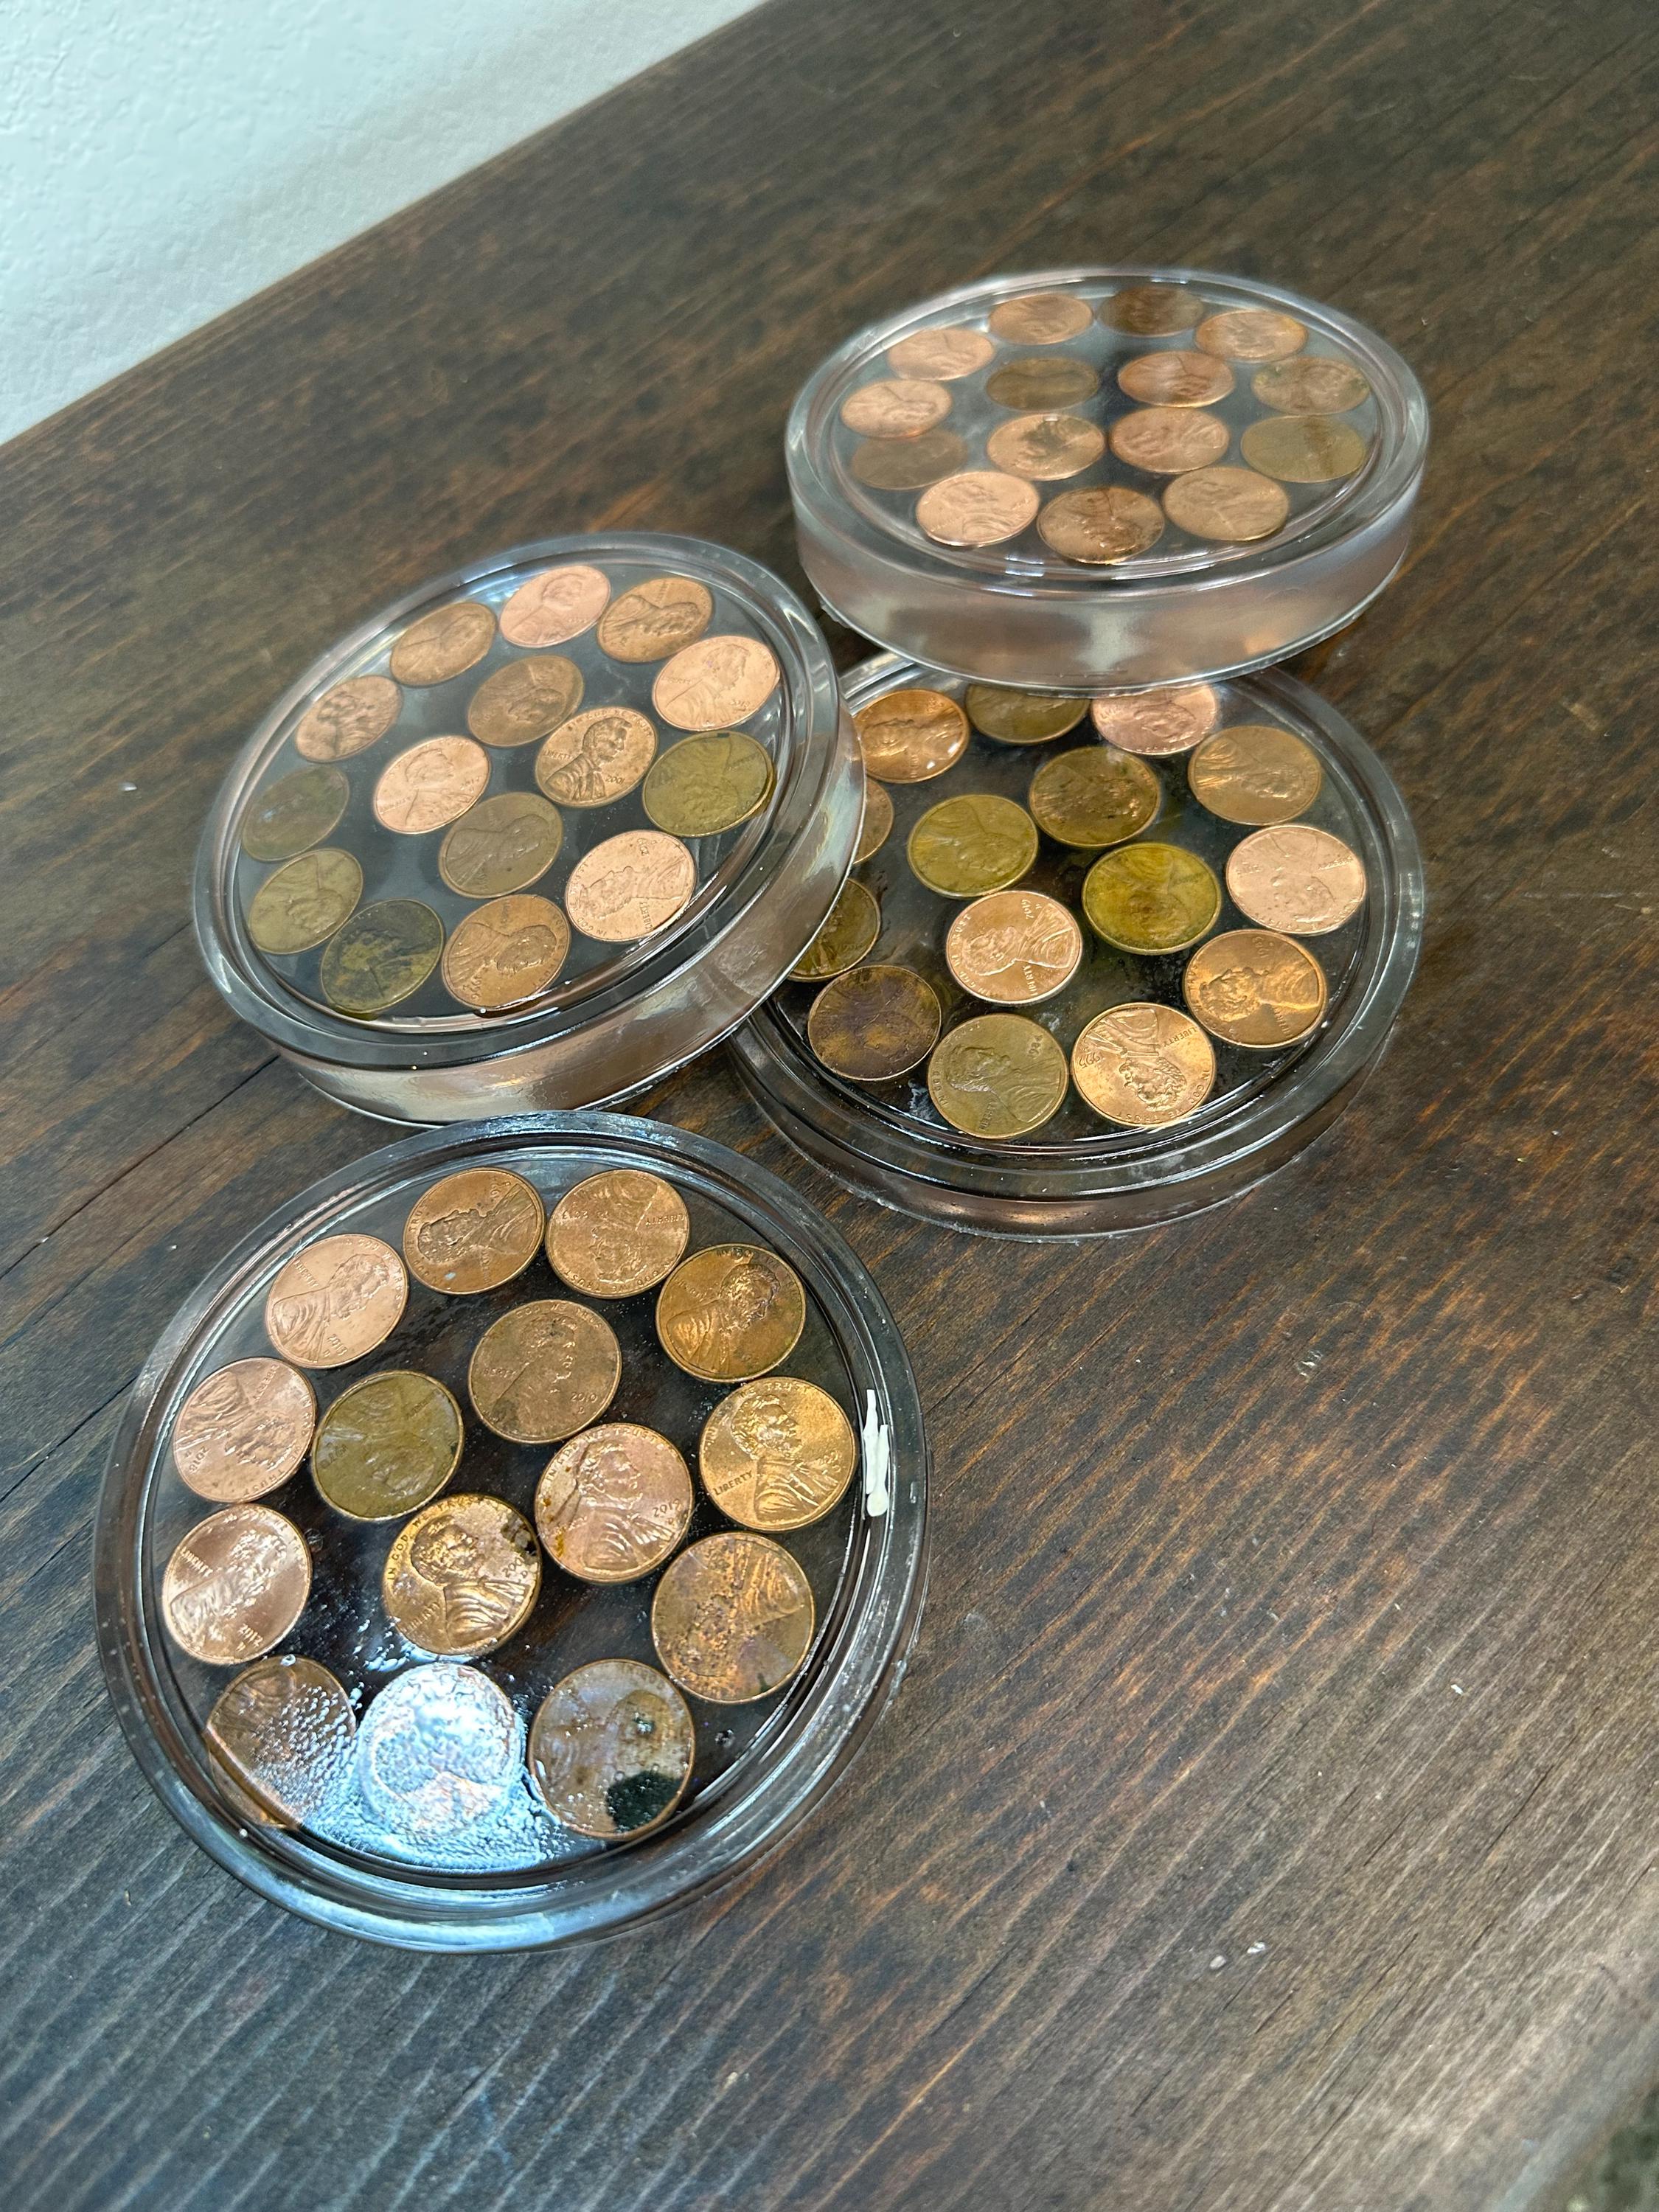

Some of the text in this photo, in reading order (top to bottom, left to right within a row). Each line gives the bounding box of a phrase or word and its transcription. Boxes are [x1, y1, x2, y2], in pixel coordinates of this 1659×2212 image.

[543, 749, 574, 760] LIBERTY
[605, 775, 626, 785] 2001
[639, 897, 655, 931] LIBERTY
[1020, 898, 1035, 920] 2019
[577, 917, 594, 931] GOD
[596, 929, 608, 937] IN
[950, 914, 973, 947] TRUST
[959, 970, 977, 989] GOD
[1023, 964, 1039, 996] LIBERTY
[1163, 1026, 1198, 1048] LIBERTY
[1078, 1052, 1106, 1071] 1995
[932, 1071, 943, 1092] GOD
[938, 1093, 950, 1107] IN
[1116, 1069, 1211, 1124] IN GOD WE TRUST
[293, 1259, 320, 1288] LIBERTY
[564, 1268, 602, 1293] TRUST
[253, 1364, 281, 1402] LIBERTY
[765, 1381, 810, 1394] TRUST
[571, 1391, 598, 1406] 2010
[188, 1445, 210, 1474] 2018
[288, 1445, 303, 1462] WE
[546, 1426, 657, 1483] IN GOD WE TRUST
[243, 1468, 286, 1497] TRUST
[712, 1470, 754, 1496] LIBERTY
[652, 1497, 682, 1519] 2019
[386, 1567, 397, 1581] IN
[392, 1534, 409, 1562] GOD
[412, 1513, 431, 1529] WE
[239, 1624, 263, 1649] 2012
